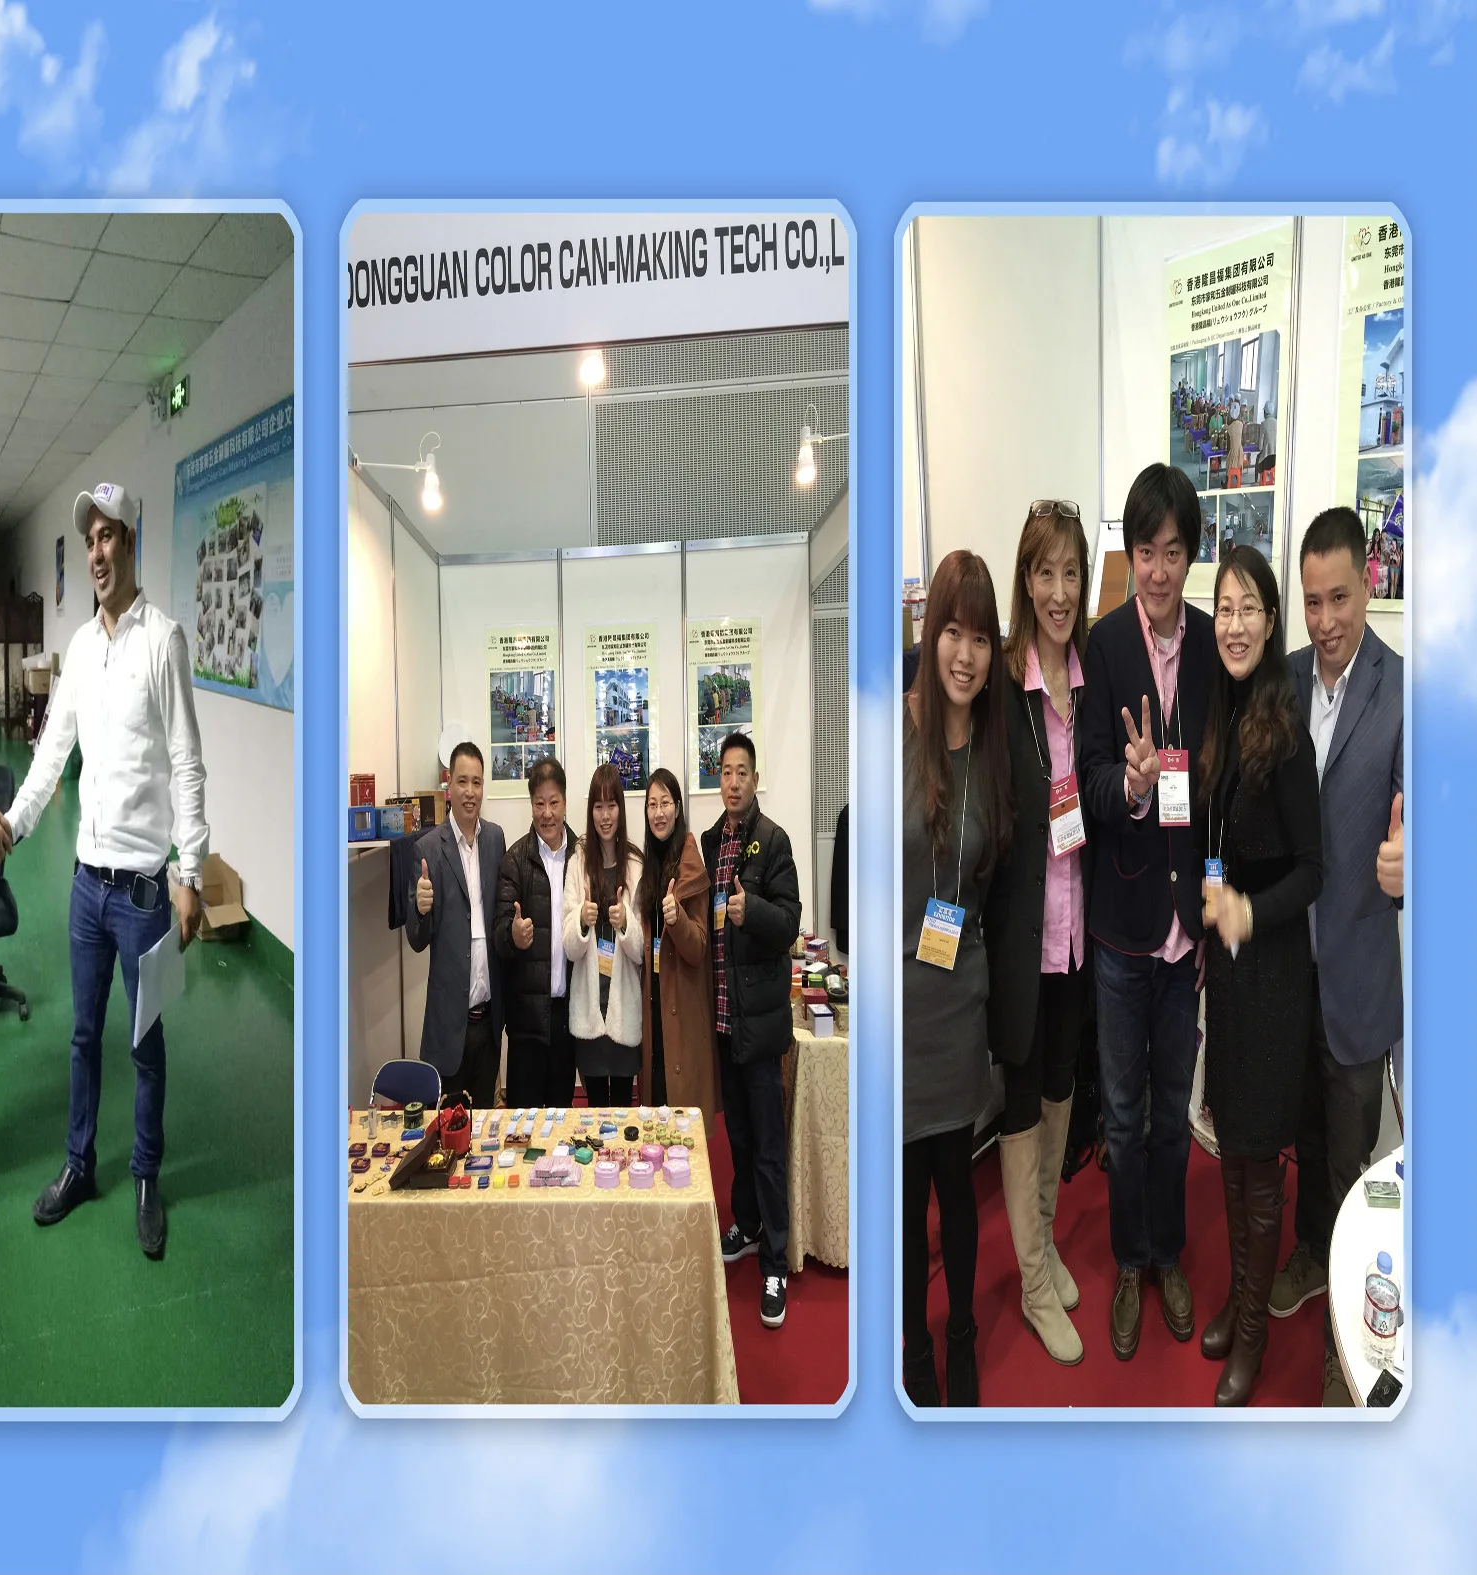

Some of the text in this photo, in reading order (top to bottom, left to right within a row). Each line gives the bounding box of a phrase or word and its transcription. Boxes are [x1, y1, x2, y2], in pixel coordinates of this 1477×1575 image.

[1378, 223, 1402, 242] 香港
[475, 242, 552, 296] COLOR
[559, 228, 708, 290] CAN-MAKING
[714, 223, 778, 274] TECH
[1384, 262, 1404, 273] Hongk
